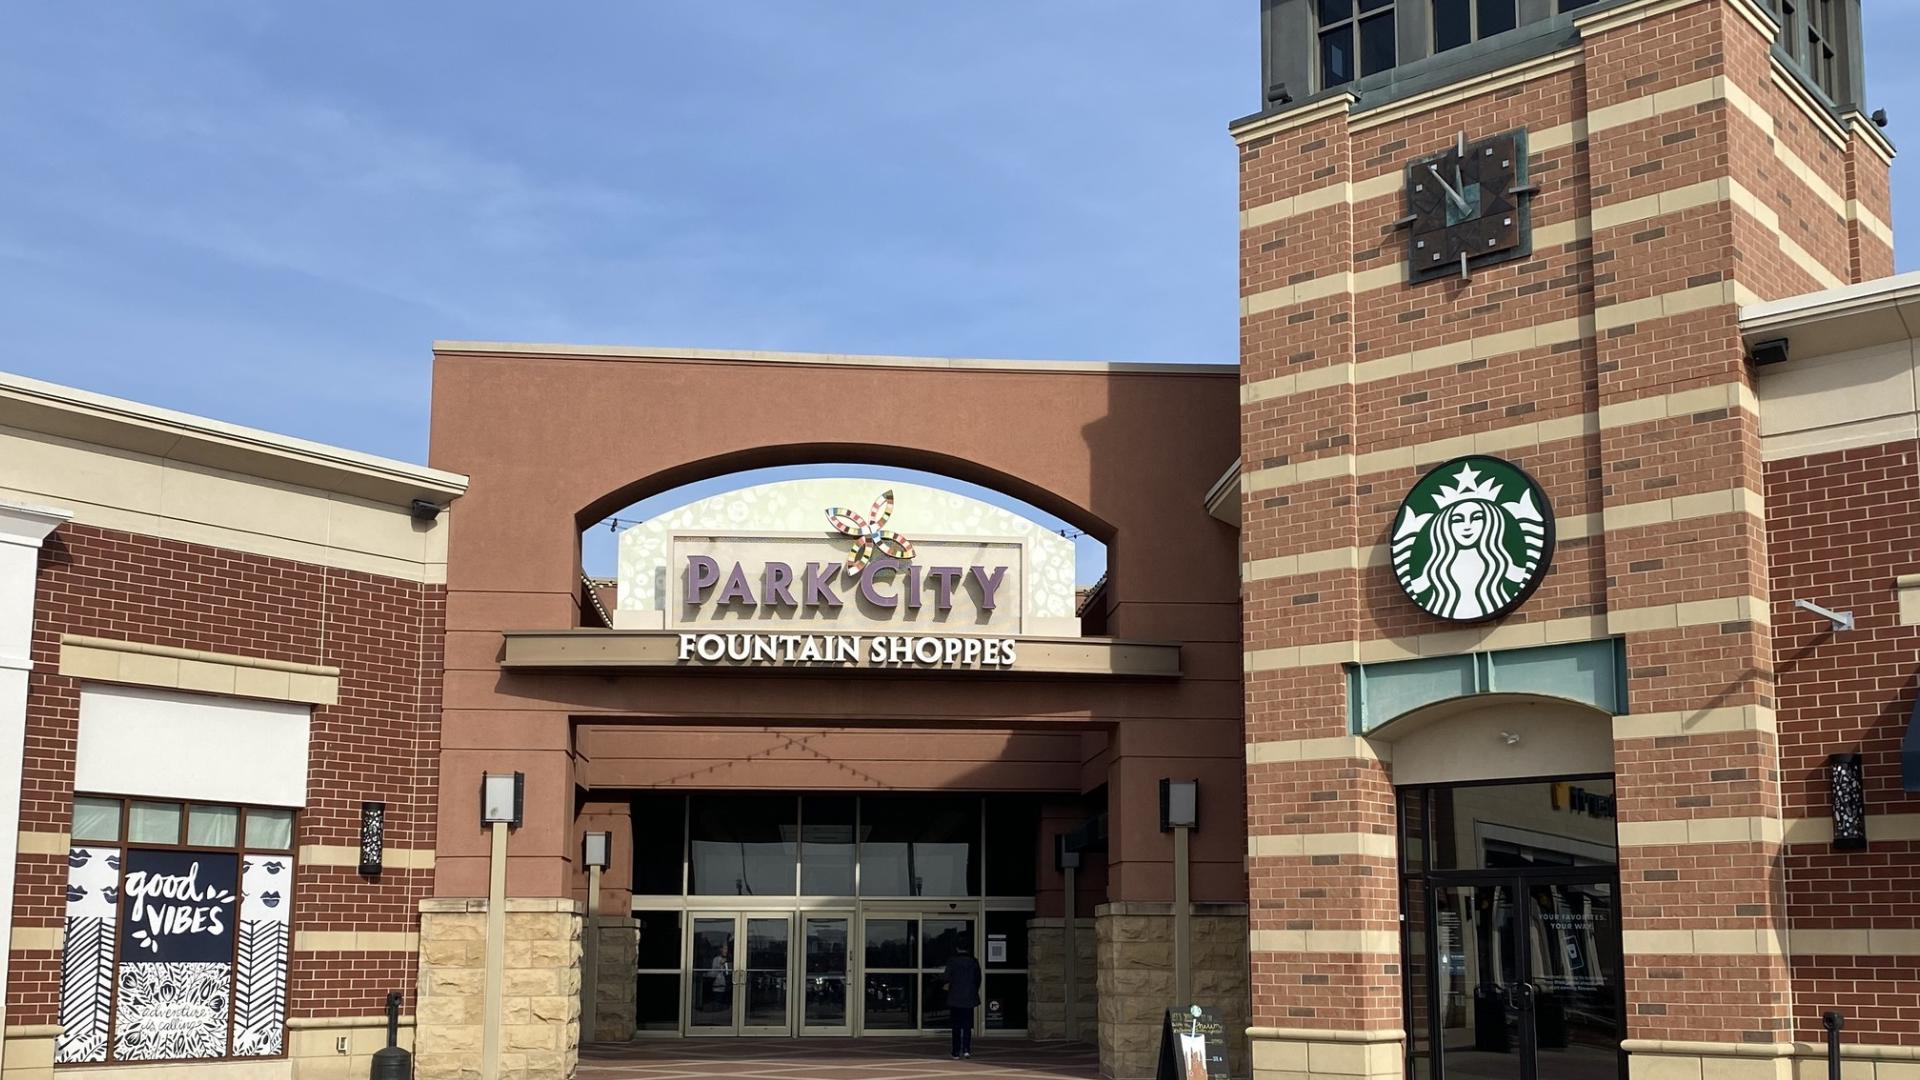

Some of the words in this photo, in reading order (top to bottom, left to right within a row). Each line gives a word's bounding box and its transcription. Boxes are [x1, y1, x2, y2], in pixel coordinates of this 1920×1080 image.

[687, 555, 844, 605] PARK
[860, 559, 1008, 609] CITY
[678, 633, 862, 662] FOUNTAIN
[871, 636, 1017, 665] SHOPPES
[125, 862, 203, 921] good
[147, 904, 224, 936] VIBES
[1538, 913, 1560, 921] YOUR
[141, 1004, 207, 1018] adventure
